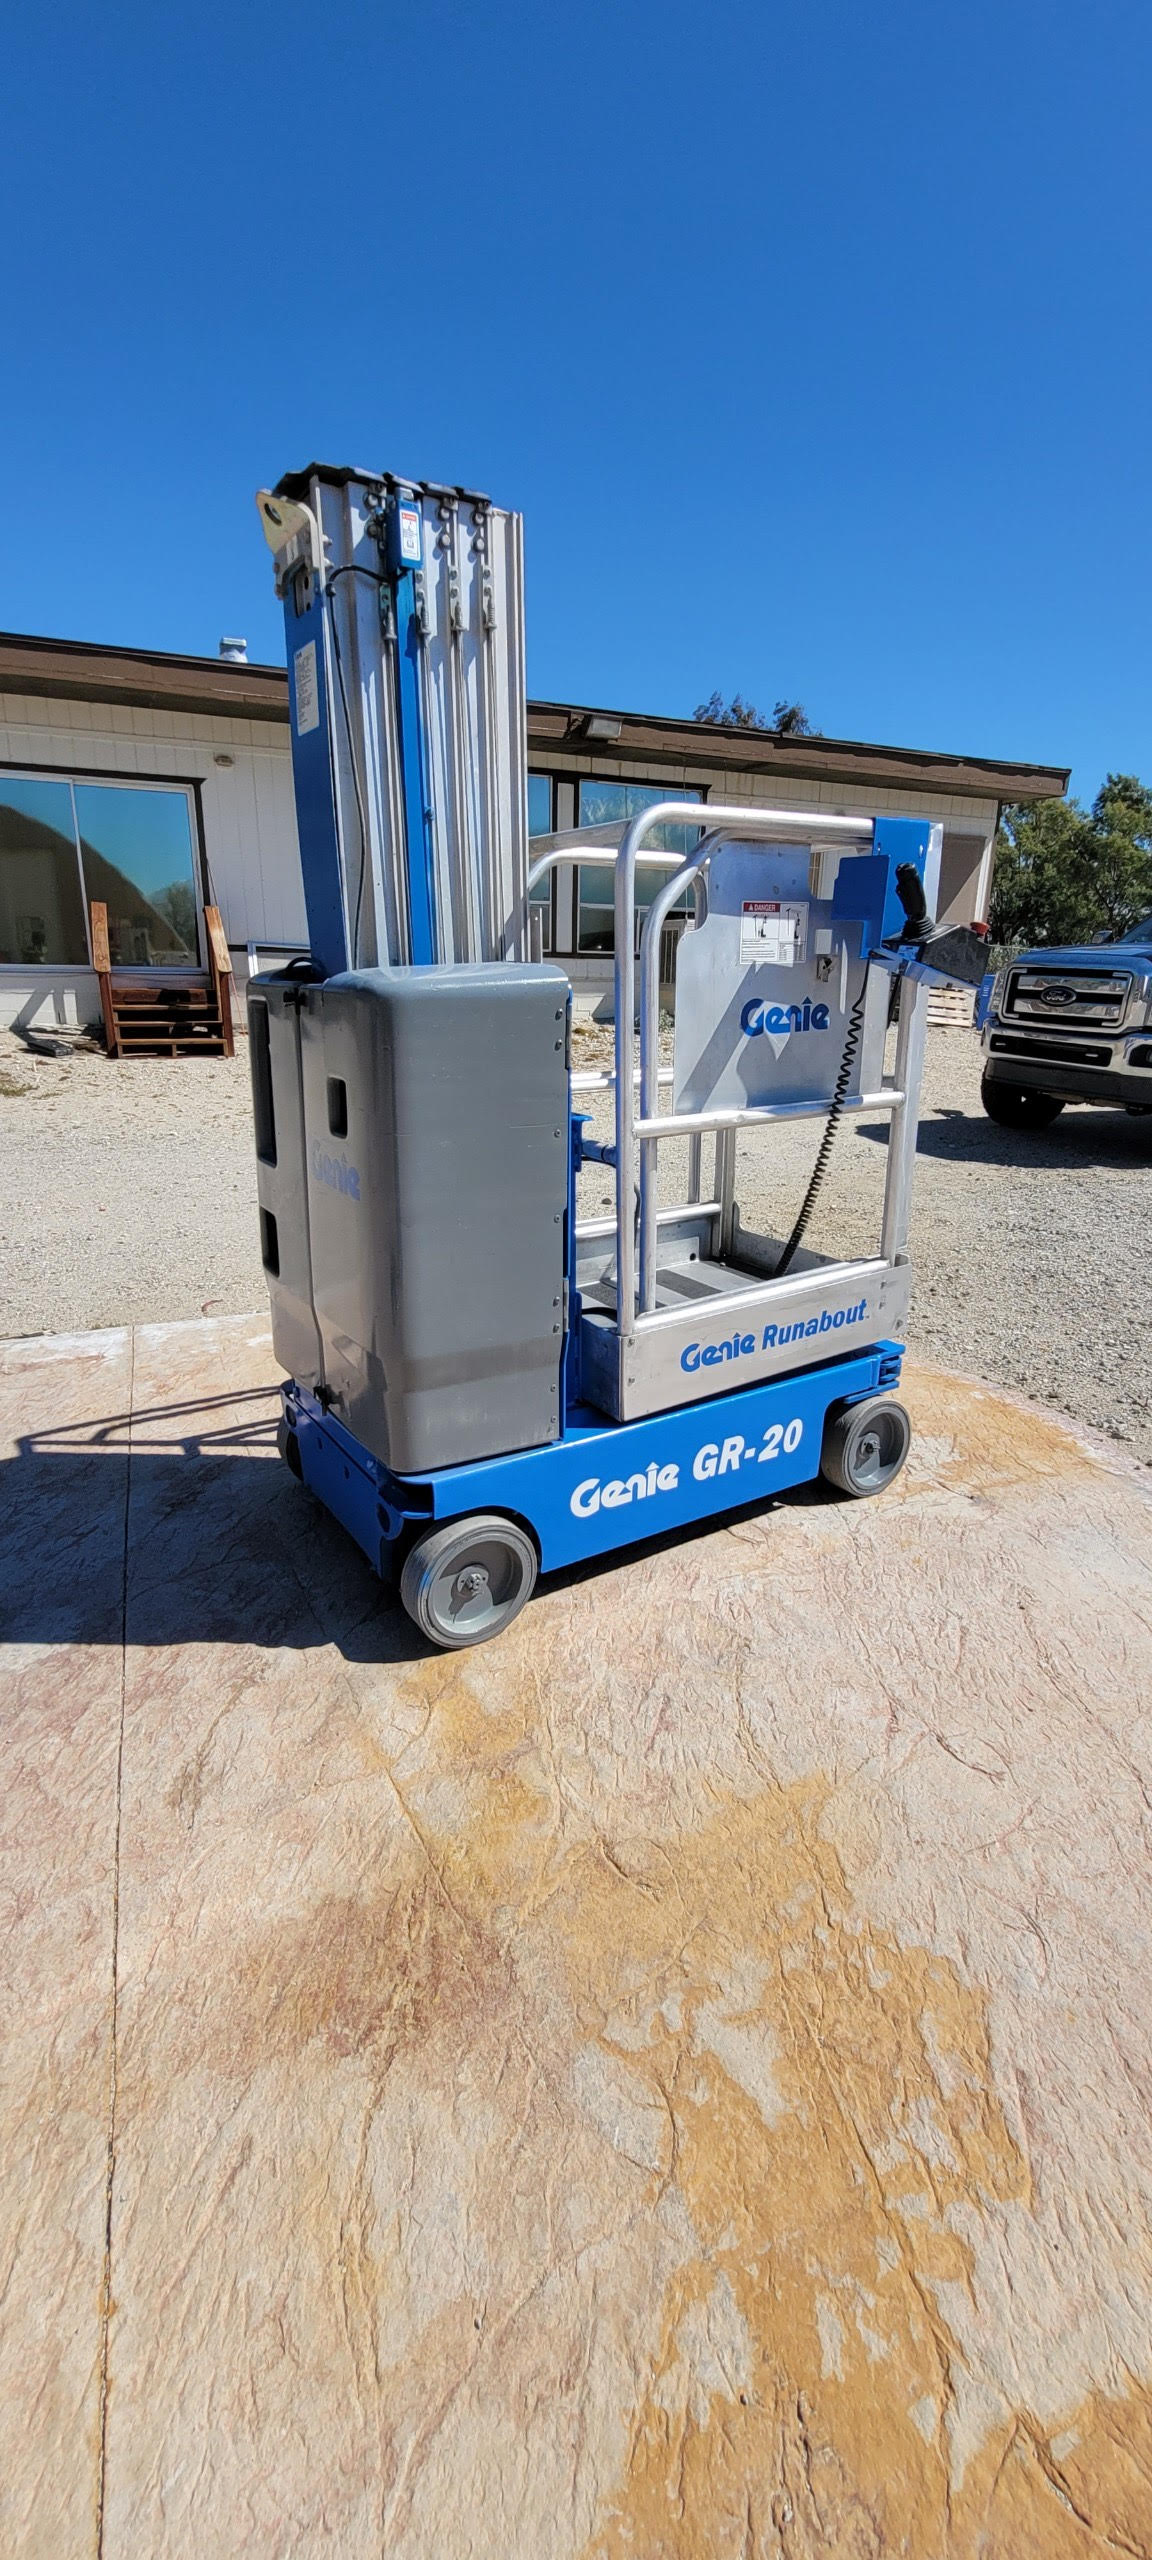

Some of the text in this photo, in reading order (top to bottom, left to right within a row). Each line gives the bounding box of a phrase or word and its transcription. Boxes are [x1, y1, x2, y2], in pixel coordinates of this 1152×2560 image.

[754, 904, 776, 912] DANGER
[741, 997, 829, 1037] Genie
[680, 1299, 867, 1372] Genie Runabout
[570, 1418, 803, 1518] Genie GR-20
